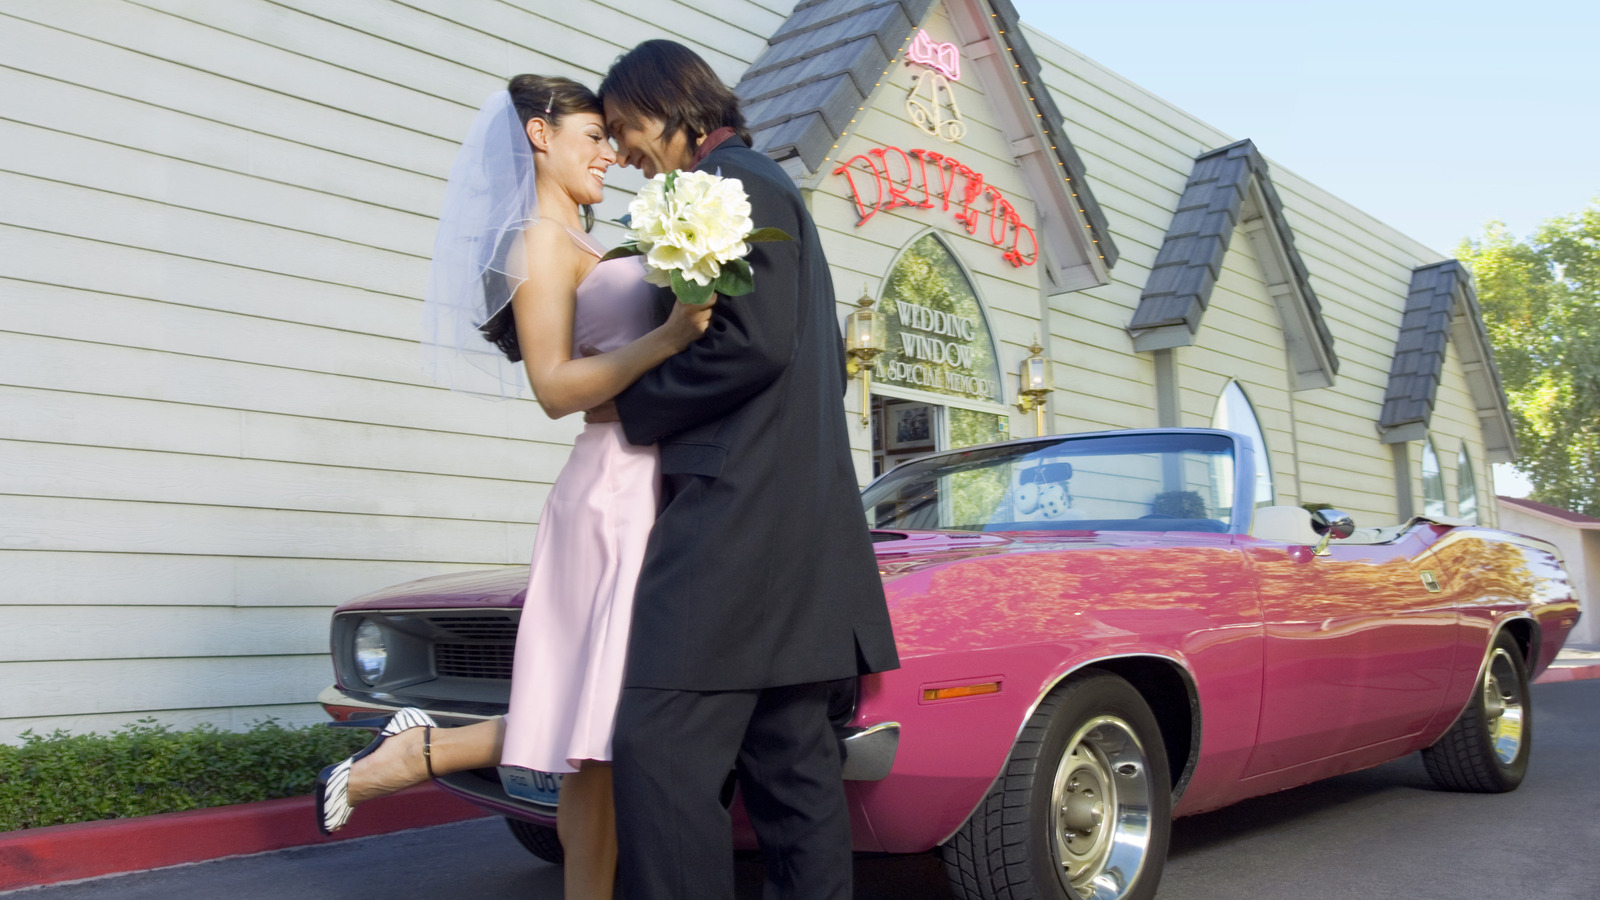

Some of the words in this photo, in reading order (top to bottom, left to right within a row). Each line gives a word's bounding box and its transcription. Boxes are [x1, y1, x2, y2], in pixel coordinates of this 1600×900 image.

[896, 300, 975, 341] WEDDING
[900, 331, 973, 369] WINDOW
[875, 359, 885, 378] A
[887, 360, 942, 388] SPECIAL
[945, 371, 996, 398] MEMORY
